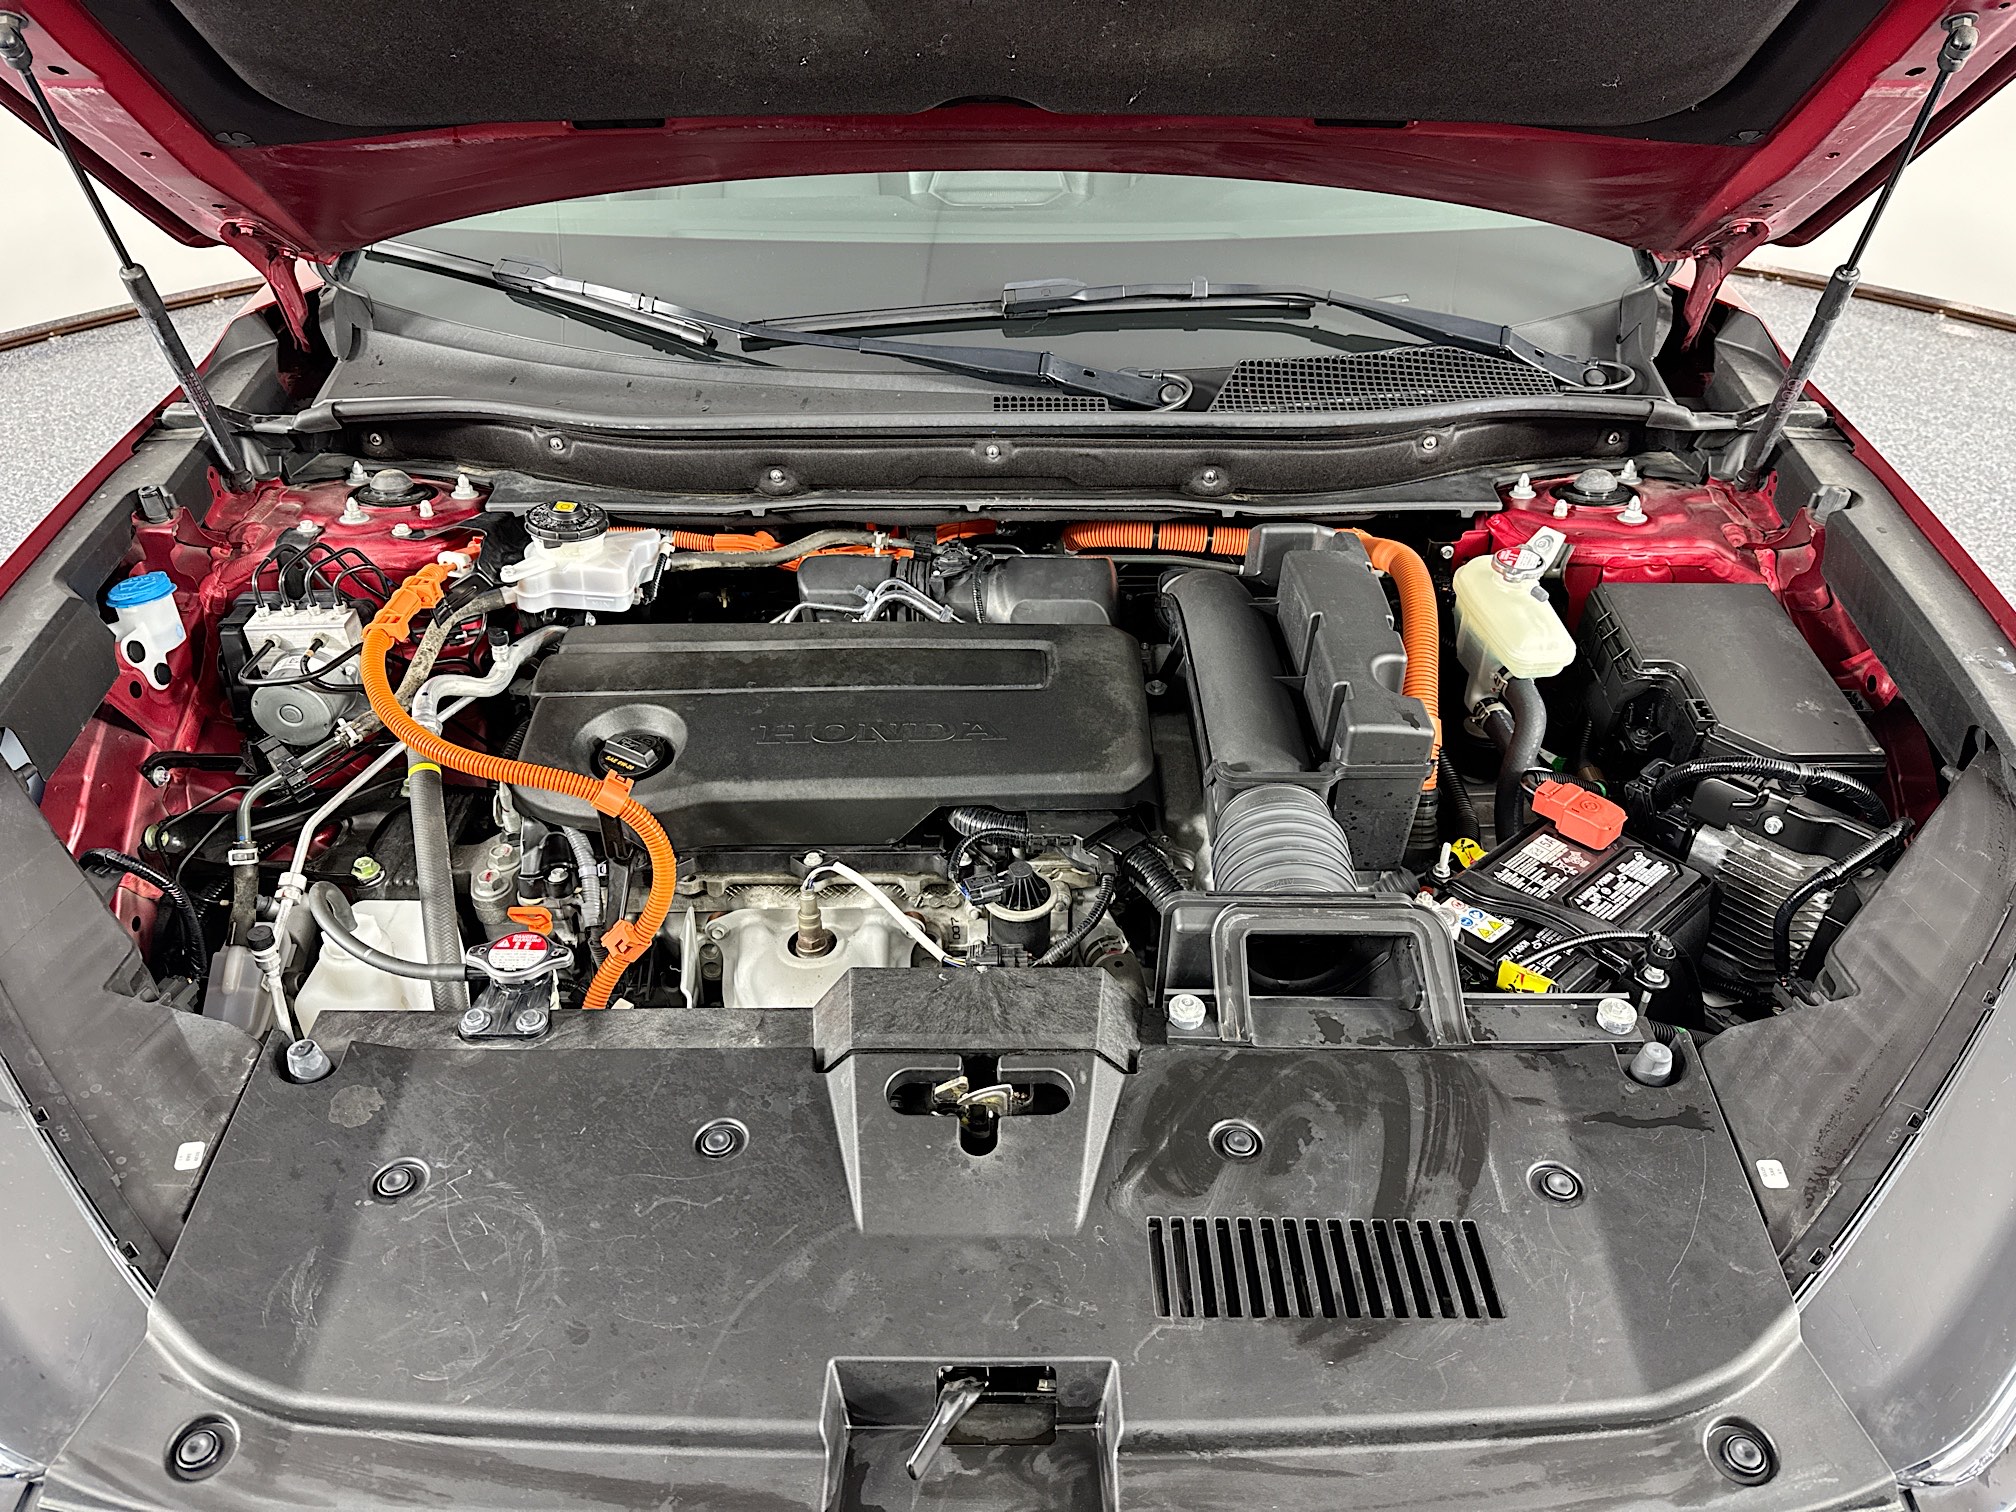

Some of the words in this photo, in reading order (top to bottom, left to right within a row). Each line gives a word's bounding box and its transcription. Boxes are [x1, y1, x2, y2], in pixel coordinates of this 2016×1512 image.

[189, 371, 210, 406] STABILUS
[756, 722, 1008, 745] HONDA
[604, 755, 619, 764] SAE
